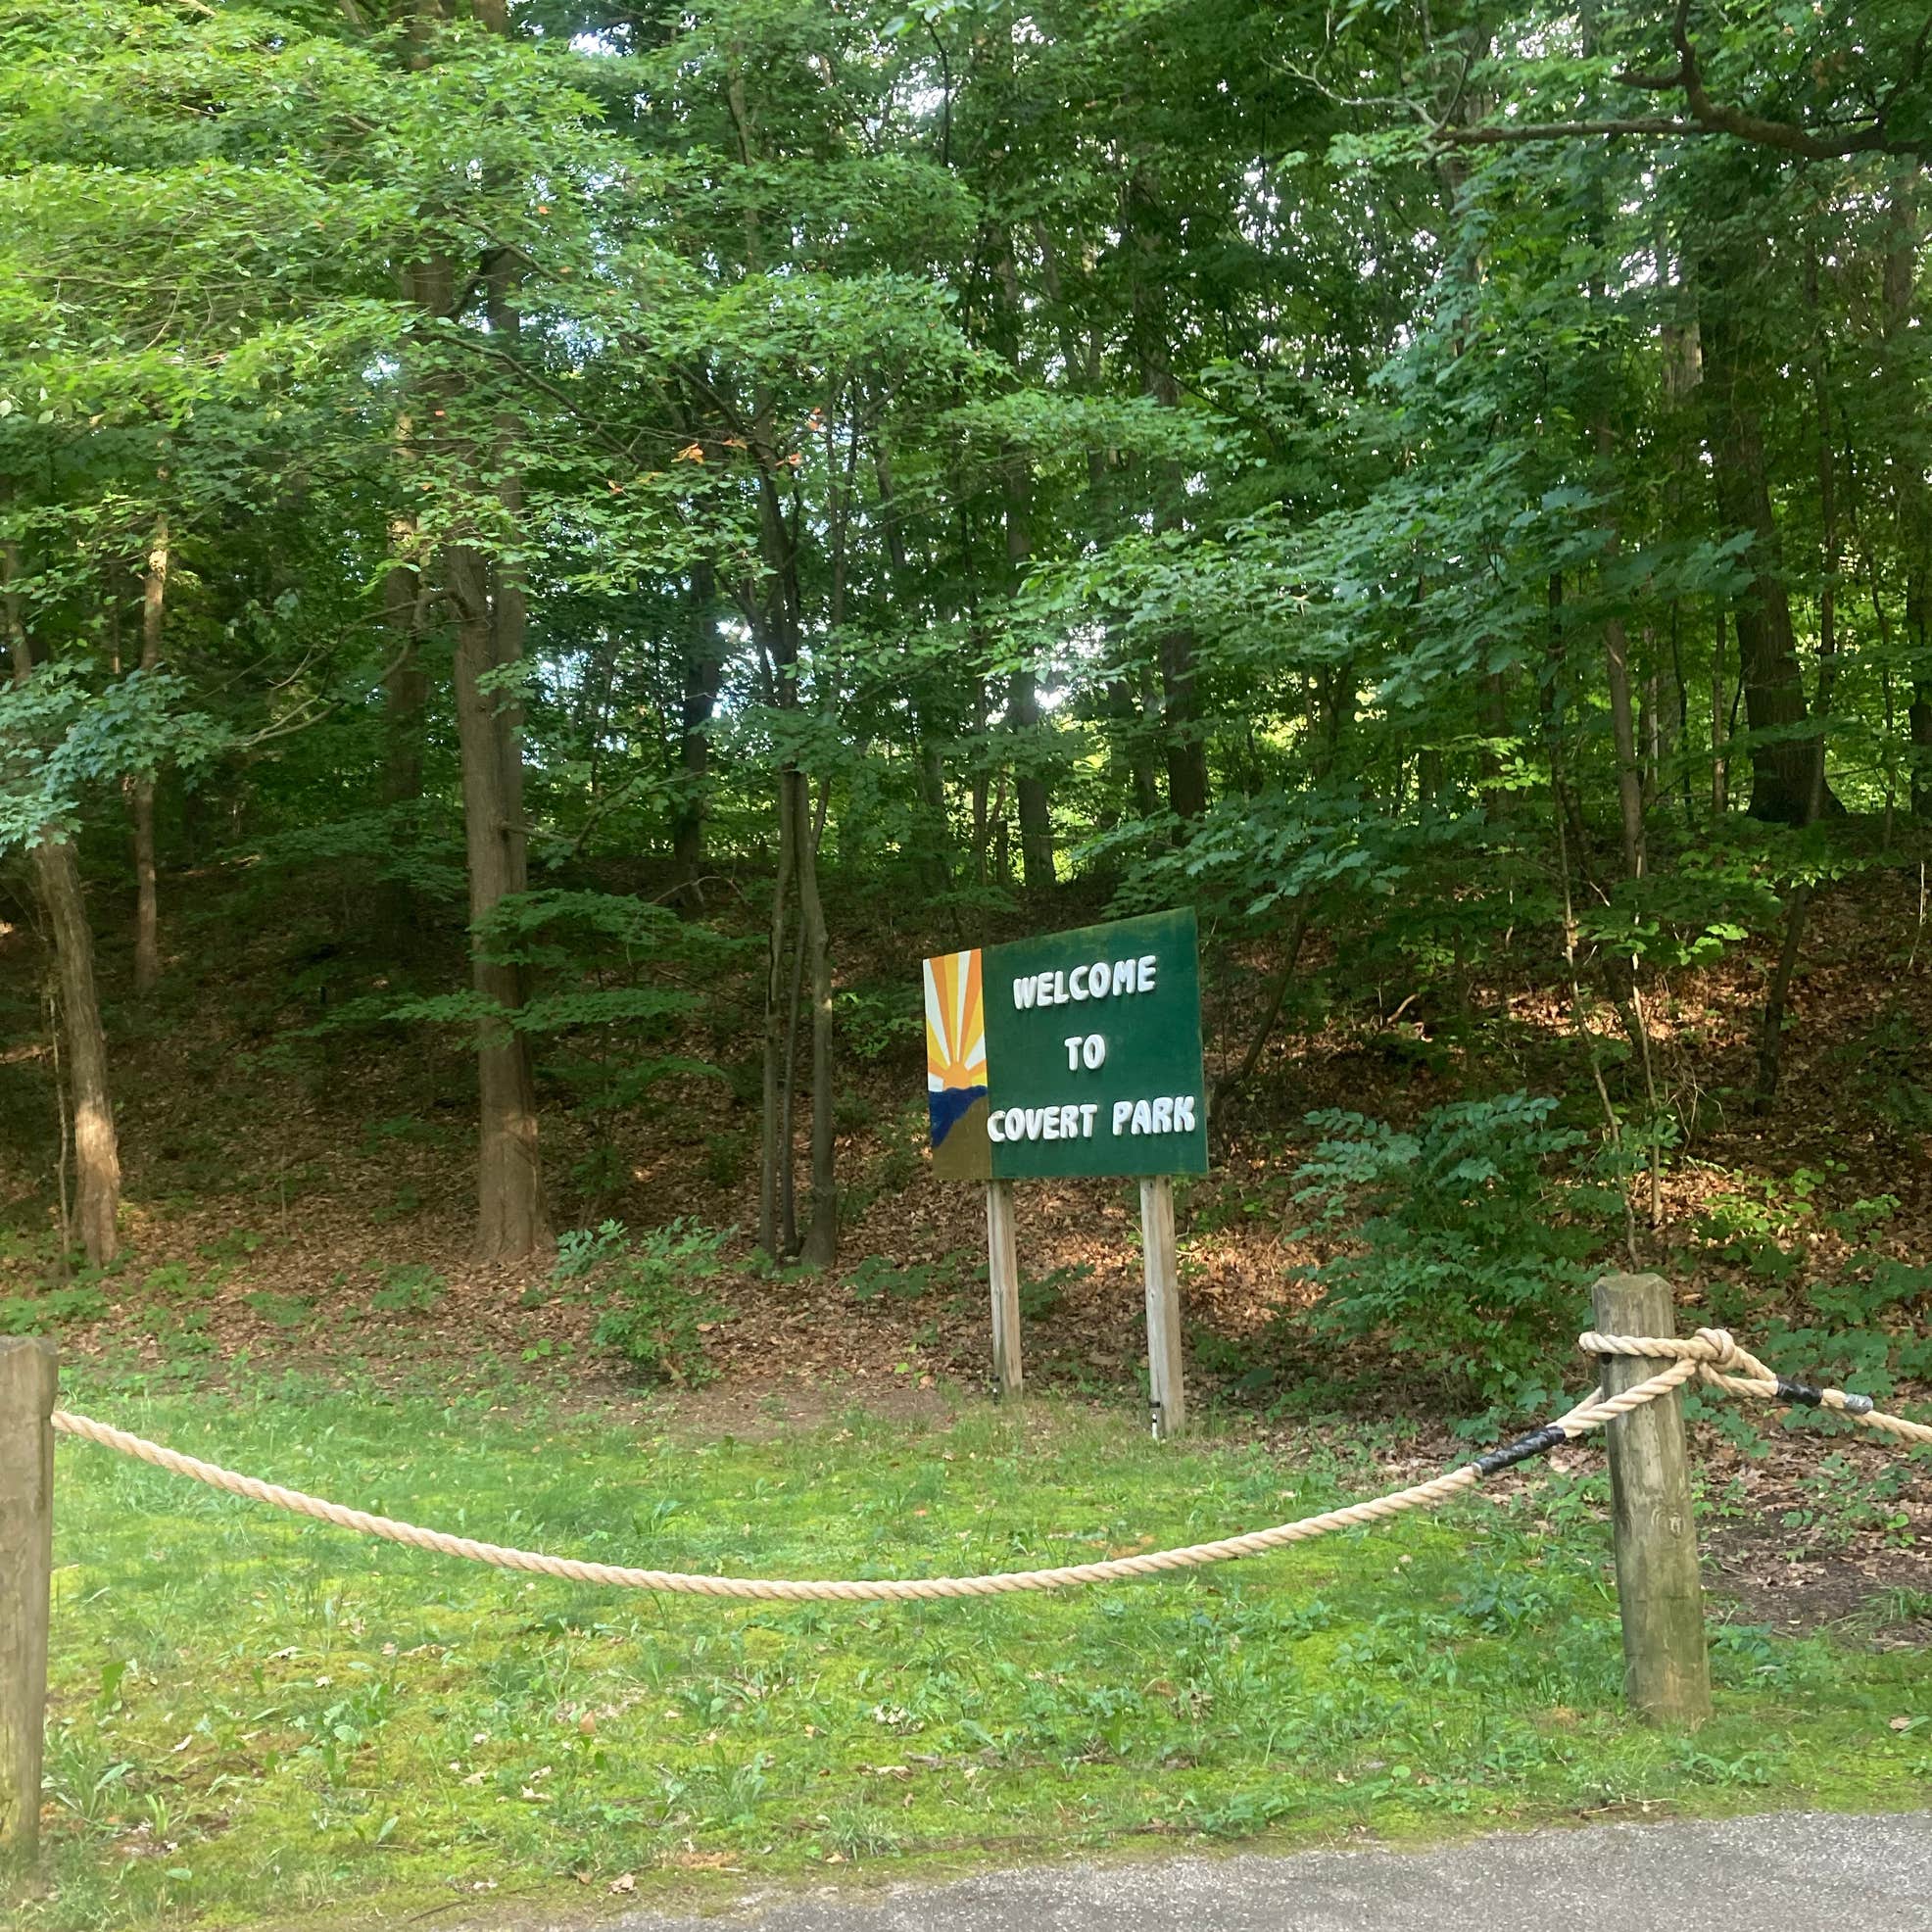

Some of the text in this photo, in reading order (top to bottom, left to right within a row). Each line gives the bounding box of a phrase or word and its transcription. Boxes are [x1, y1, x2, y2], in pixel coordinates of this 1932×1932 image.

[1012, 954, 1157, 1010] WELCOME
[1064, 1034, 1106, 1071] TO
[987, 1095, 1196, 1142] COVERT PARK
